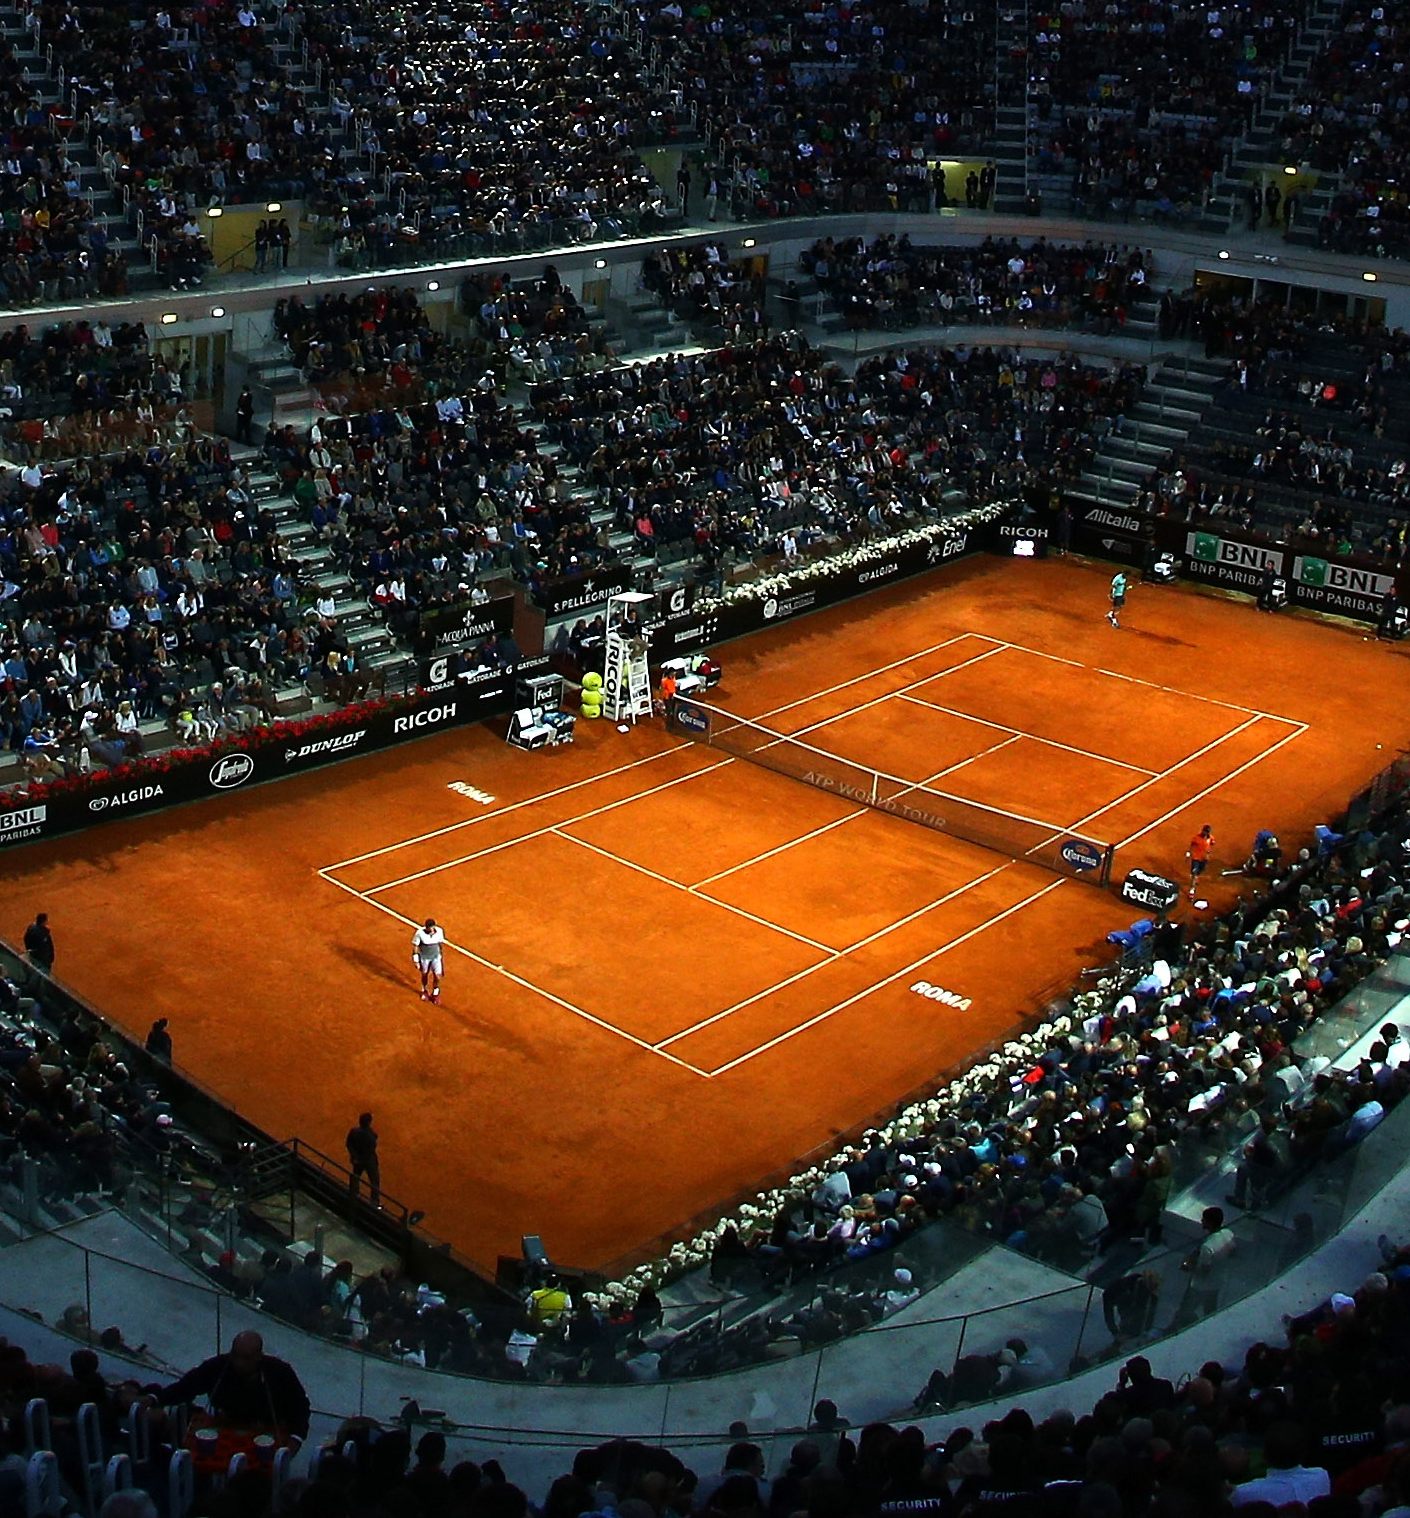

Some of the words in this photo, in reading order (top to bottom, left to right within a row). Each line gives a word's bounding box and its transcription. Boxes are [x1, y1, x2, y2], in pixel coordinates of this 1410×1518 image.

[1000, 526, 1048, 538] RICOH
[1084, 509, 1140, 531] Alitalia
[942, 534, 967, 557] Enel
[1190, 561, 1216, 575] BNP
[1218, 567, 1264, 587] PARIBA
[1330, 566, 1384, 595] BNL
[1297, 586, 1324, 600] BNP
[1326, 593, 1384, 616] PARIBAS
[441, 628, 468, 644] ACQUA
[469, 620, 495, 637] PANNA
[606, 645, 620, 709] RICOH
[394, 702, 457, 734] RICOH
[298, 729, 367, 757] DUNLOP
[110, 784, 164, 807] ALGIDA
[447, 781, 495, 805] ROMA
[1, 809, 39, 830] BNL
[0, 826, 41, 842] PARIBAS
[1122, 881, 1164, 909] FedEx
[910, 981, 972, 1011] ROMA
[880, 1498, 942, 1512] SECURITY
